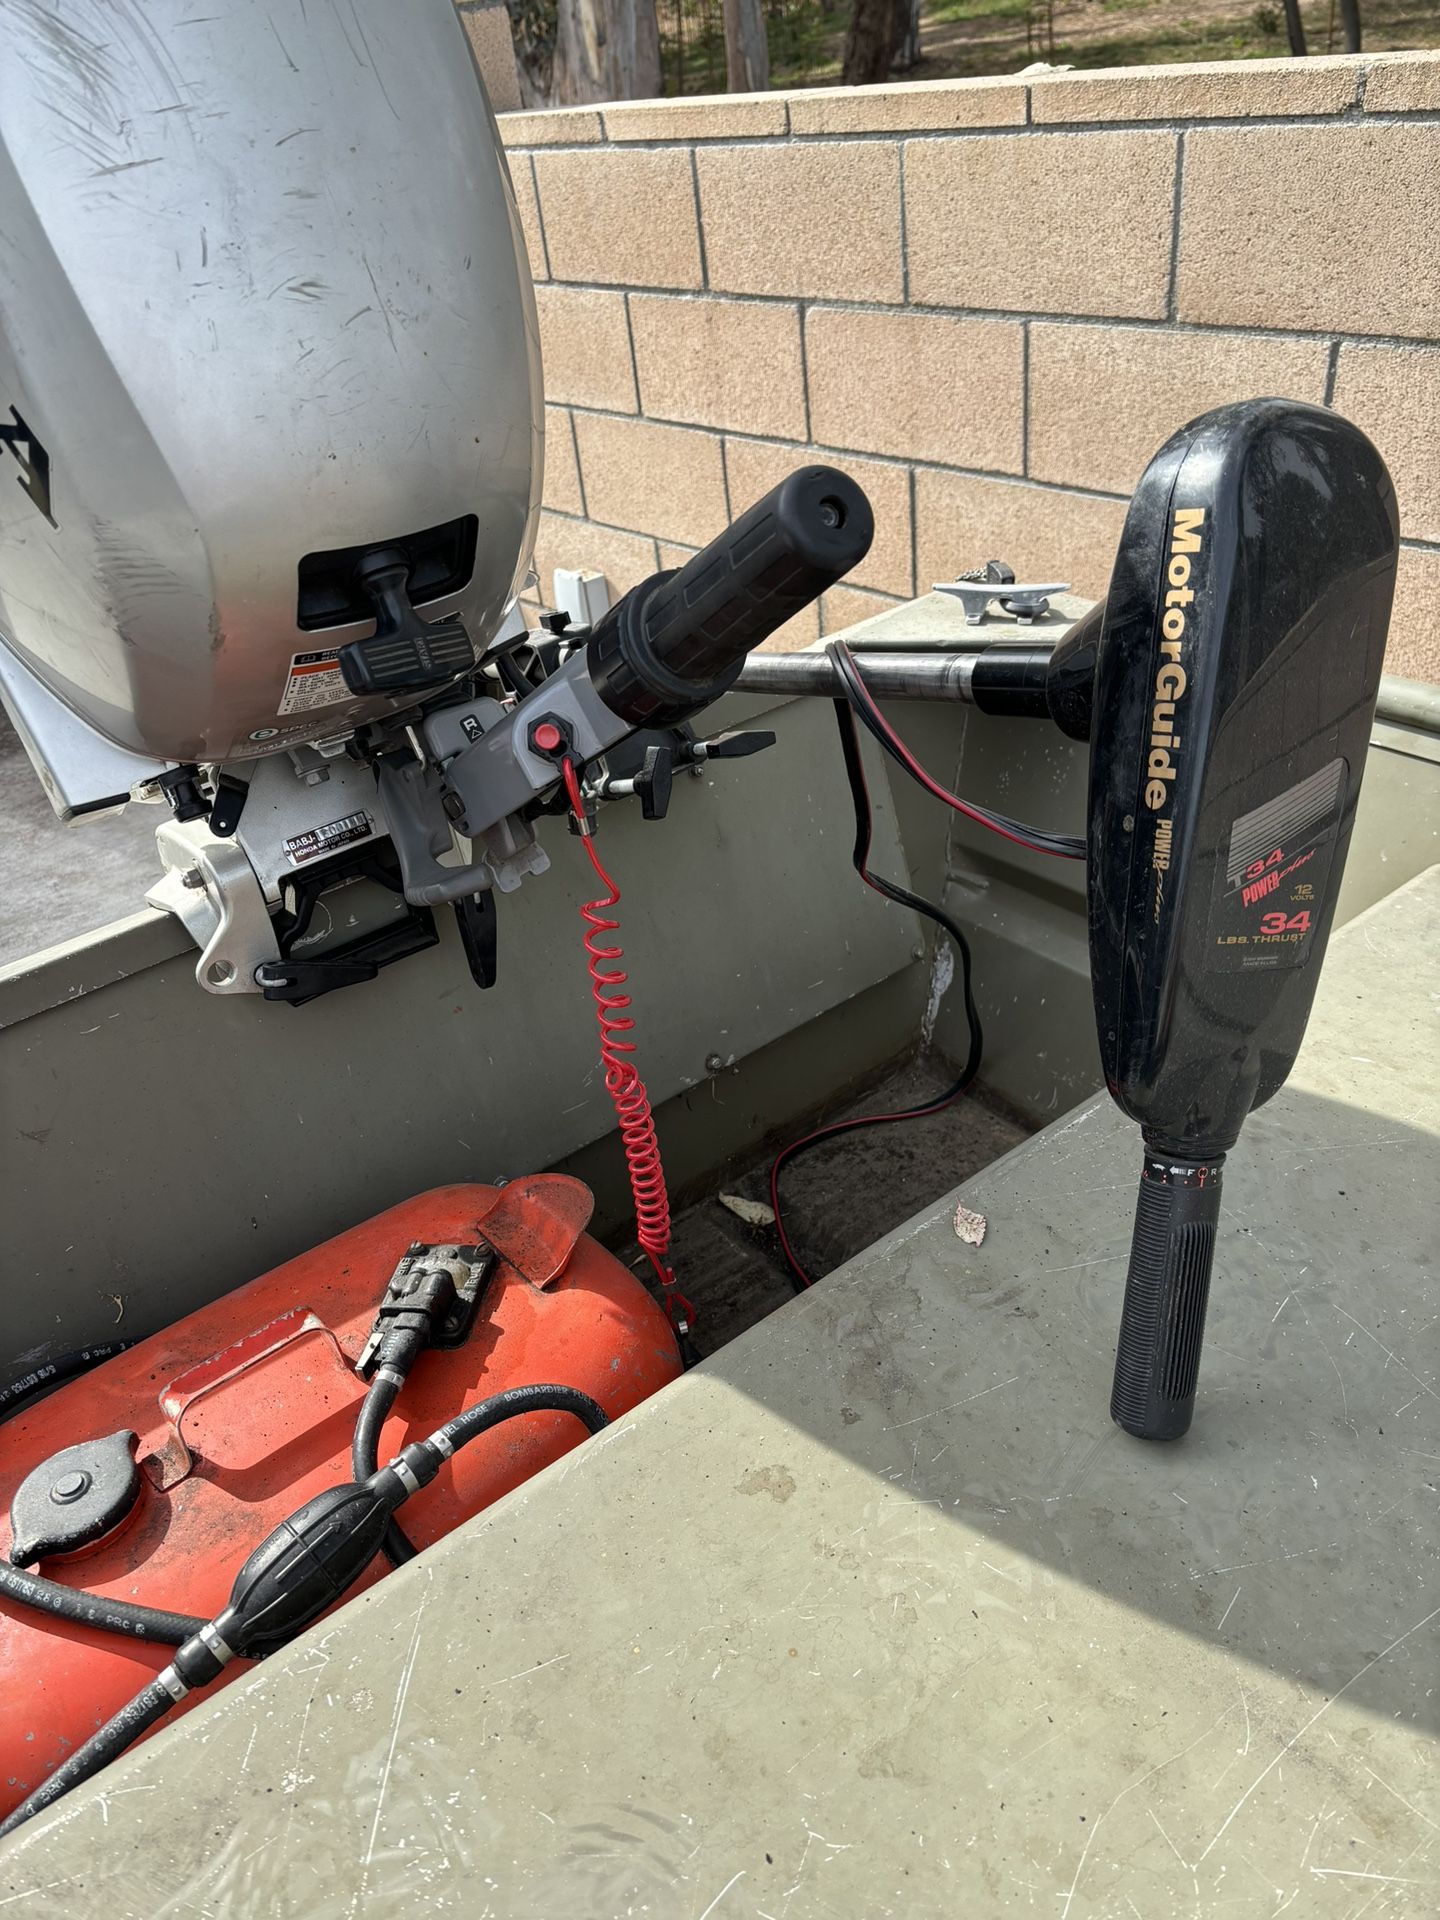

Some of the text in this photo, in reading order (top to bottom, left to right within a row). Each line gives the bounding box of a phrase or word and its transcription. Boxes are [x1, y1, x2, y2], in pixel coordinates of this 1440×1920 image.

[1145, 508, 1206, 811] MotorGuide
[463, 718, 478, 731] R
[295, 845, 318, 857] HONDA
[318, 836, 340, 848] MOTOR
[354, 825, 367, 834] LTD.
[1152, 819, 1173, 870] POWER
[1241, 869, 1280, 908] POWER
[1294, 884, 1313, 894] 12
[1260, 910, 1311, 935] 34
[1217, 932, 1306, 945] LBS. THRUST
[1187, 1169, 1196, 1177] F
[1210, 1168, 1217, 1176] R
[460, 1404, 488, 1425] HOSE
[503, 1385, 569, 1402] BOMBARDIER
